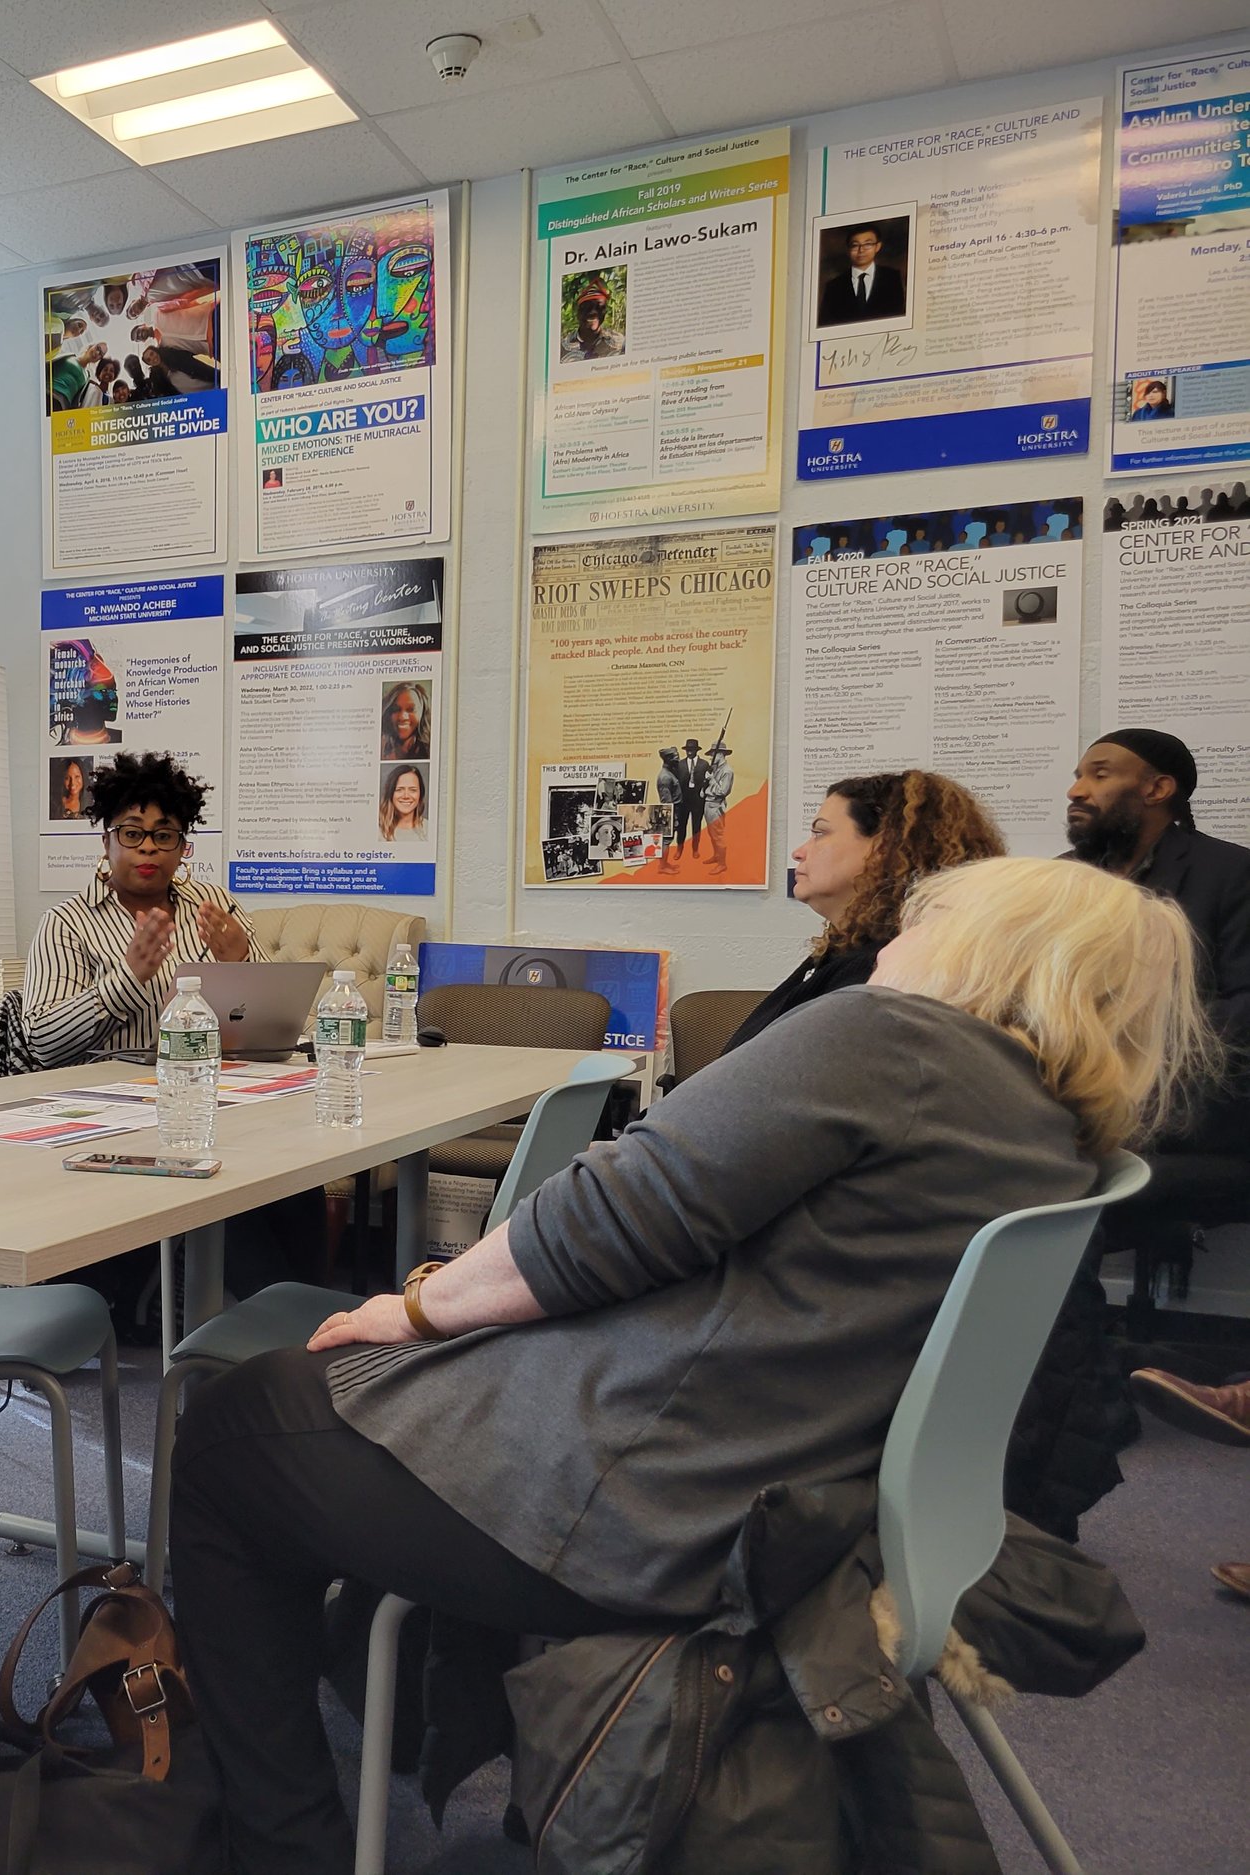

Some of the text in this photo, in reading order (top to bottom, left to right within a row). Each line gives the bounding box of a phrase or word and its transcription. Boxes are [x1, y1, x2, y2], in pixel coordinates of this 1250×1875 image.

[1130, 74, 1164, 86] Center
[1168, 71, 1181, 80] for
[1130, 80, 1196, 96] Social Justice
[1129, 100, 1250, 129] Asylum Under
[844, 150, 865, 160] THE
[869, 139, 914, 155] CENTER
[918, 134, 941, 147] FOR
[994, 115, 1048, 132] CULTURE
[1052, 109, 1080, 123] AND
[882, 129, 1037, 165] SOCIAL JUSTICE PRESENTS
[566, 175, 579, 184] The
[582, 171, 607, 181] Center
[610, 167, 621, 175] for
[656, 154, 685, 165] Culture
[687, 150, 702, 159] and
[705, 144, 728, 155] Social
[730, 139, 759, 150] Justice
[638, 183, 681, 200] Fall 2019
[548, 180, 778, 231] Distinguished African Scholars and Writers Series
[565, 220, 758, 265] Dr. Alain Lawo-Sukam
[929, 240, 967, 253] Tuesday
[970, 236, 992, 249] April
[996, 234, 1007, 243] 16
[1050, 225, 1071, 235] p.m.
[1191, 242, 1241, 256] Monday,
[261, 396, 281, 404] CENTER
[283, 393, 294, 401] FOR
[318, 386, 341, 395] CULTURE
[358, 380, 378, 389] SOCIAL
[379, 376, 401, 385] JUSTICE
[91, 407, 204, 433] INTERCULTURALITY:
[260, 399, 418, 440] WHO ARE YOU?
[91, 430, 148, 446] BRIDGING
[152, 424, 175, 438] THE
[179, 418, 219, 434] DIVIDE
[262, 425, 421, 455] MIXED EMOTIONS: THE MULTIRACIAL
[1017, 430, 1077, 445] HOFSTRA
[262, 446, 354, 466] STUDENT EXPERIENCE
[807, 453, 862, 467] HOFSTRA
[601, 502, 714, 521] HOFSTRA UNIVERSITY
[1121, 515, 1203, 530] SPRING 2021
[1120, 526, 1240, 549] CENTER FOR
[583, 554, 637, 568] Chicago
[808, 551, 863, 564] FALL 2020
[1120, 546, 1203, 565] CULTURE
[287, 567, 396, 585] HOFSTRA UNIVERSITY
[806, 566, 870, 582] CENTER
[876, 562, 909, 578] FOR
[806, 564, 1066, 598] CULTURE AND SOCIAL JUSTICE
[534, 568, 771, 604] RIOT SWEEPS CHICAGO
[84, 599, 176, 614] DR. NWANDO ACHEBE
[240, 636, 434, 654] AND SOCIAL JUSTICE PRESENTS A WORKSHOP:
[262, 636, 277, 644] THE
[280, 634, 312, 643] CENTER
[314, 633, 331, 641] FOR
[369, 628, 410, 638] CULTURE,
[571, 638, 593, 648] years
[595, 636, 612, 647] ago,
[615, 633, 638, 644] white
[640, 632, 663, 642] mobs
[666, 632, 693, 641] across
[696, 629, 709, 639] the
[712, 628, 748, 639] country
[182, 654, 190, 663] of
[551, 650, 585, 660] attacked
[588, 648, 610, 657] Black
[613, 648, 643, 658] people.
[646, 645, 665, 654] And
[667, 643, 686, 654] they
[688, 641, 717, 652] fought
[126, 664, 217, 677] Knowledge Production
[138, 678, 166, 686] African
[169, 676, 199, 684] Women
[143, 688, 174, 696] Gender:
[126, 698, 190, 707] Whose Histories
[237, 850, 255, 858] Visit
[356, 851, 395, 860] register.
[604, 1033, 645, 1046] STICE
